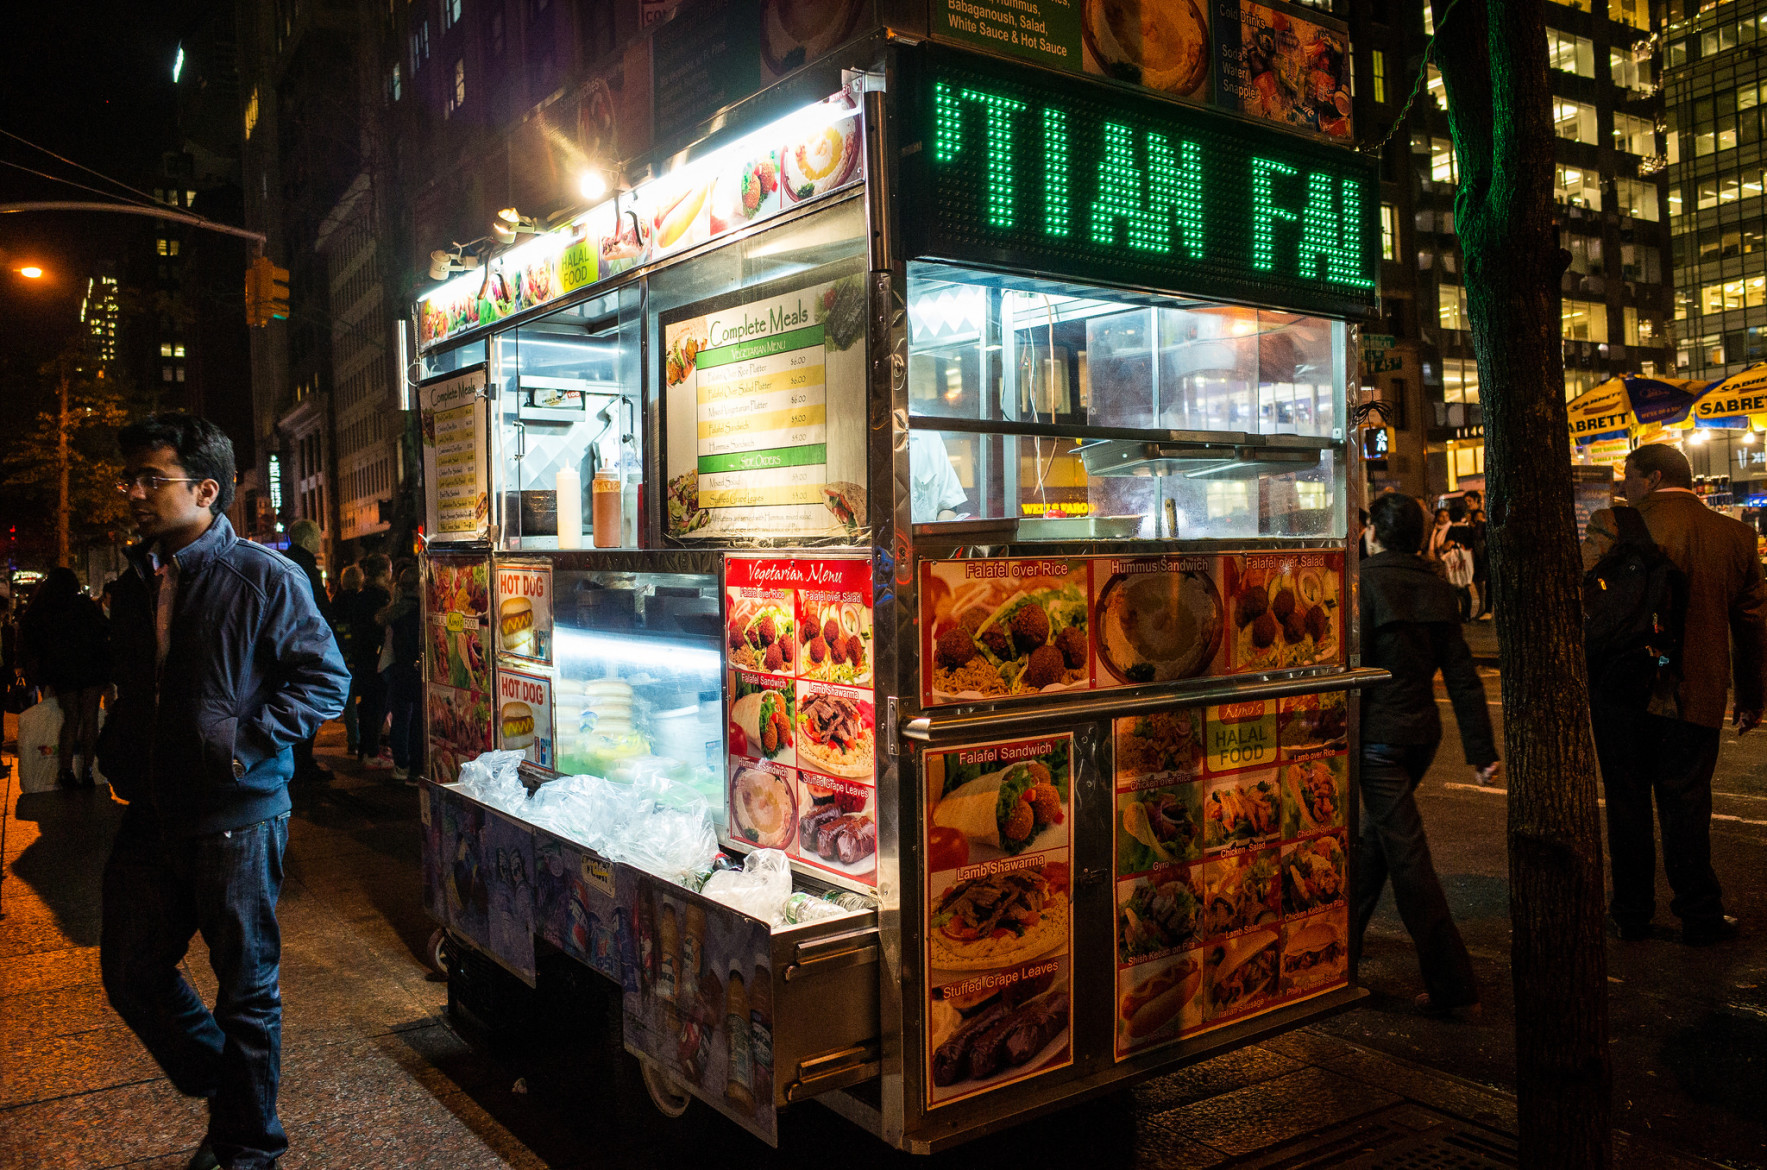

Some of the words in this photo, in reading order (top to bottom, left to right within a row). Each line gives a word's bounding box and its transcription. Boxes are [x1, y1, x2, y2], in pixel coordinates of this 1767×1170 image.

[1020, 15, 1048, 36] Salad,
[1219, 3, 1239, 21] Cold
[1240, 9, 1266, 29] Drinks
[948, 13, 977, 33] White
[979, 21, 1009, 42] Sauce
[1011, 30, 1019, 44] &
[1021, 32, 1038, 49] Hot
[1039, 37, 1068, 57] Sauce
[1222, 60, 1246, 79] Water
[561, 245, 590, 272] HALAL
[563, 267, 588, 289] FOOD
[710, 313, 767, 348] Complete
[769, 299, 809, 335] Meals
[430, 384, 458, 408] Complete
[458, 378, 476, 399] Meals
[1699, 395, 1767, 415] SABRE
[966, 561, 1009, 579] Falafel
[1011, 564, 1038, 578] over
[1039, 562, 1069, 577] Rice
[1110, 559, 1159, 574] Hummus
[1159, 557, 1209, 573] Sandwich
[1245, 556, 1277, 570] Falafel
[1277, 558, 1299, 569] over
[1300, 556, 1326, 568] Salad
[749, 560, 804, 587] Vegetarian
[806, 563, 843, 584] Menu
[500, 574, 521, 595] HOT
[523, 575, 544, 597] DOG
[740, 587, 757, 598] Falafel
[757, 590, 771, 599] over
[771, 589, 785, 600] Rice
[805, 591, 826, 601] Falafel
[826, 593, 840, 602] over
[842, 591, 862, 603] Salad
[501, 676, 521, 699] HOT
[523, 681, 544, 706] DOG
[741, 673, 759, 684] Falafel
[760, 675, 787, 689] Sandwich
[809, 681, 827, 694] Lamb
[827, 684, 860, 700] Shawarma
[1215, 725, 1268, 748] HALAL
[959, 748, 998, 766] Falafel
[1000, 741, 1053, 760] Sandwich
[1220, 744, 1264, 766] FOOD
[1294, 752, 1310, 763] Lamb
[1310, 751, 1322, 760] over
[1323, 748, 1336, 758] Rice
[760, 762, 788, 779] Sandwich
[803, 773, 824, 787] Stuffed
[824, 778, 845, 794] Grape
[845, 784, 869, 799] Leaves
[1130, 778, 1159, 792] Chicken
[1159, 777, 1175, 788] over
[1176, 774, 1192, 784] Rice
[1220, 845, 1246, 858] Chicken
[1249, 841, 1266, 853] Salad
[957, 864, 988, 882] Lamb
[989, 854, 1046, 876] Shawarma
[1152, 861, 1170, 872] Gyro
[1225, 929, 1243, 940] Lamb
[1128, 953, 1148, 966] Shish
[943, 977, 982, 1000] Stuffed
[985, 970, 1019, 990] Grape
[1021, 960, 1059, 981] Leaves
